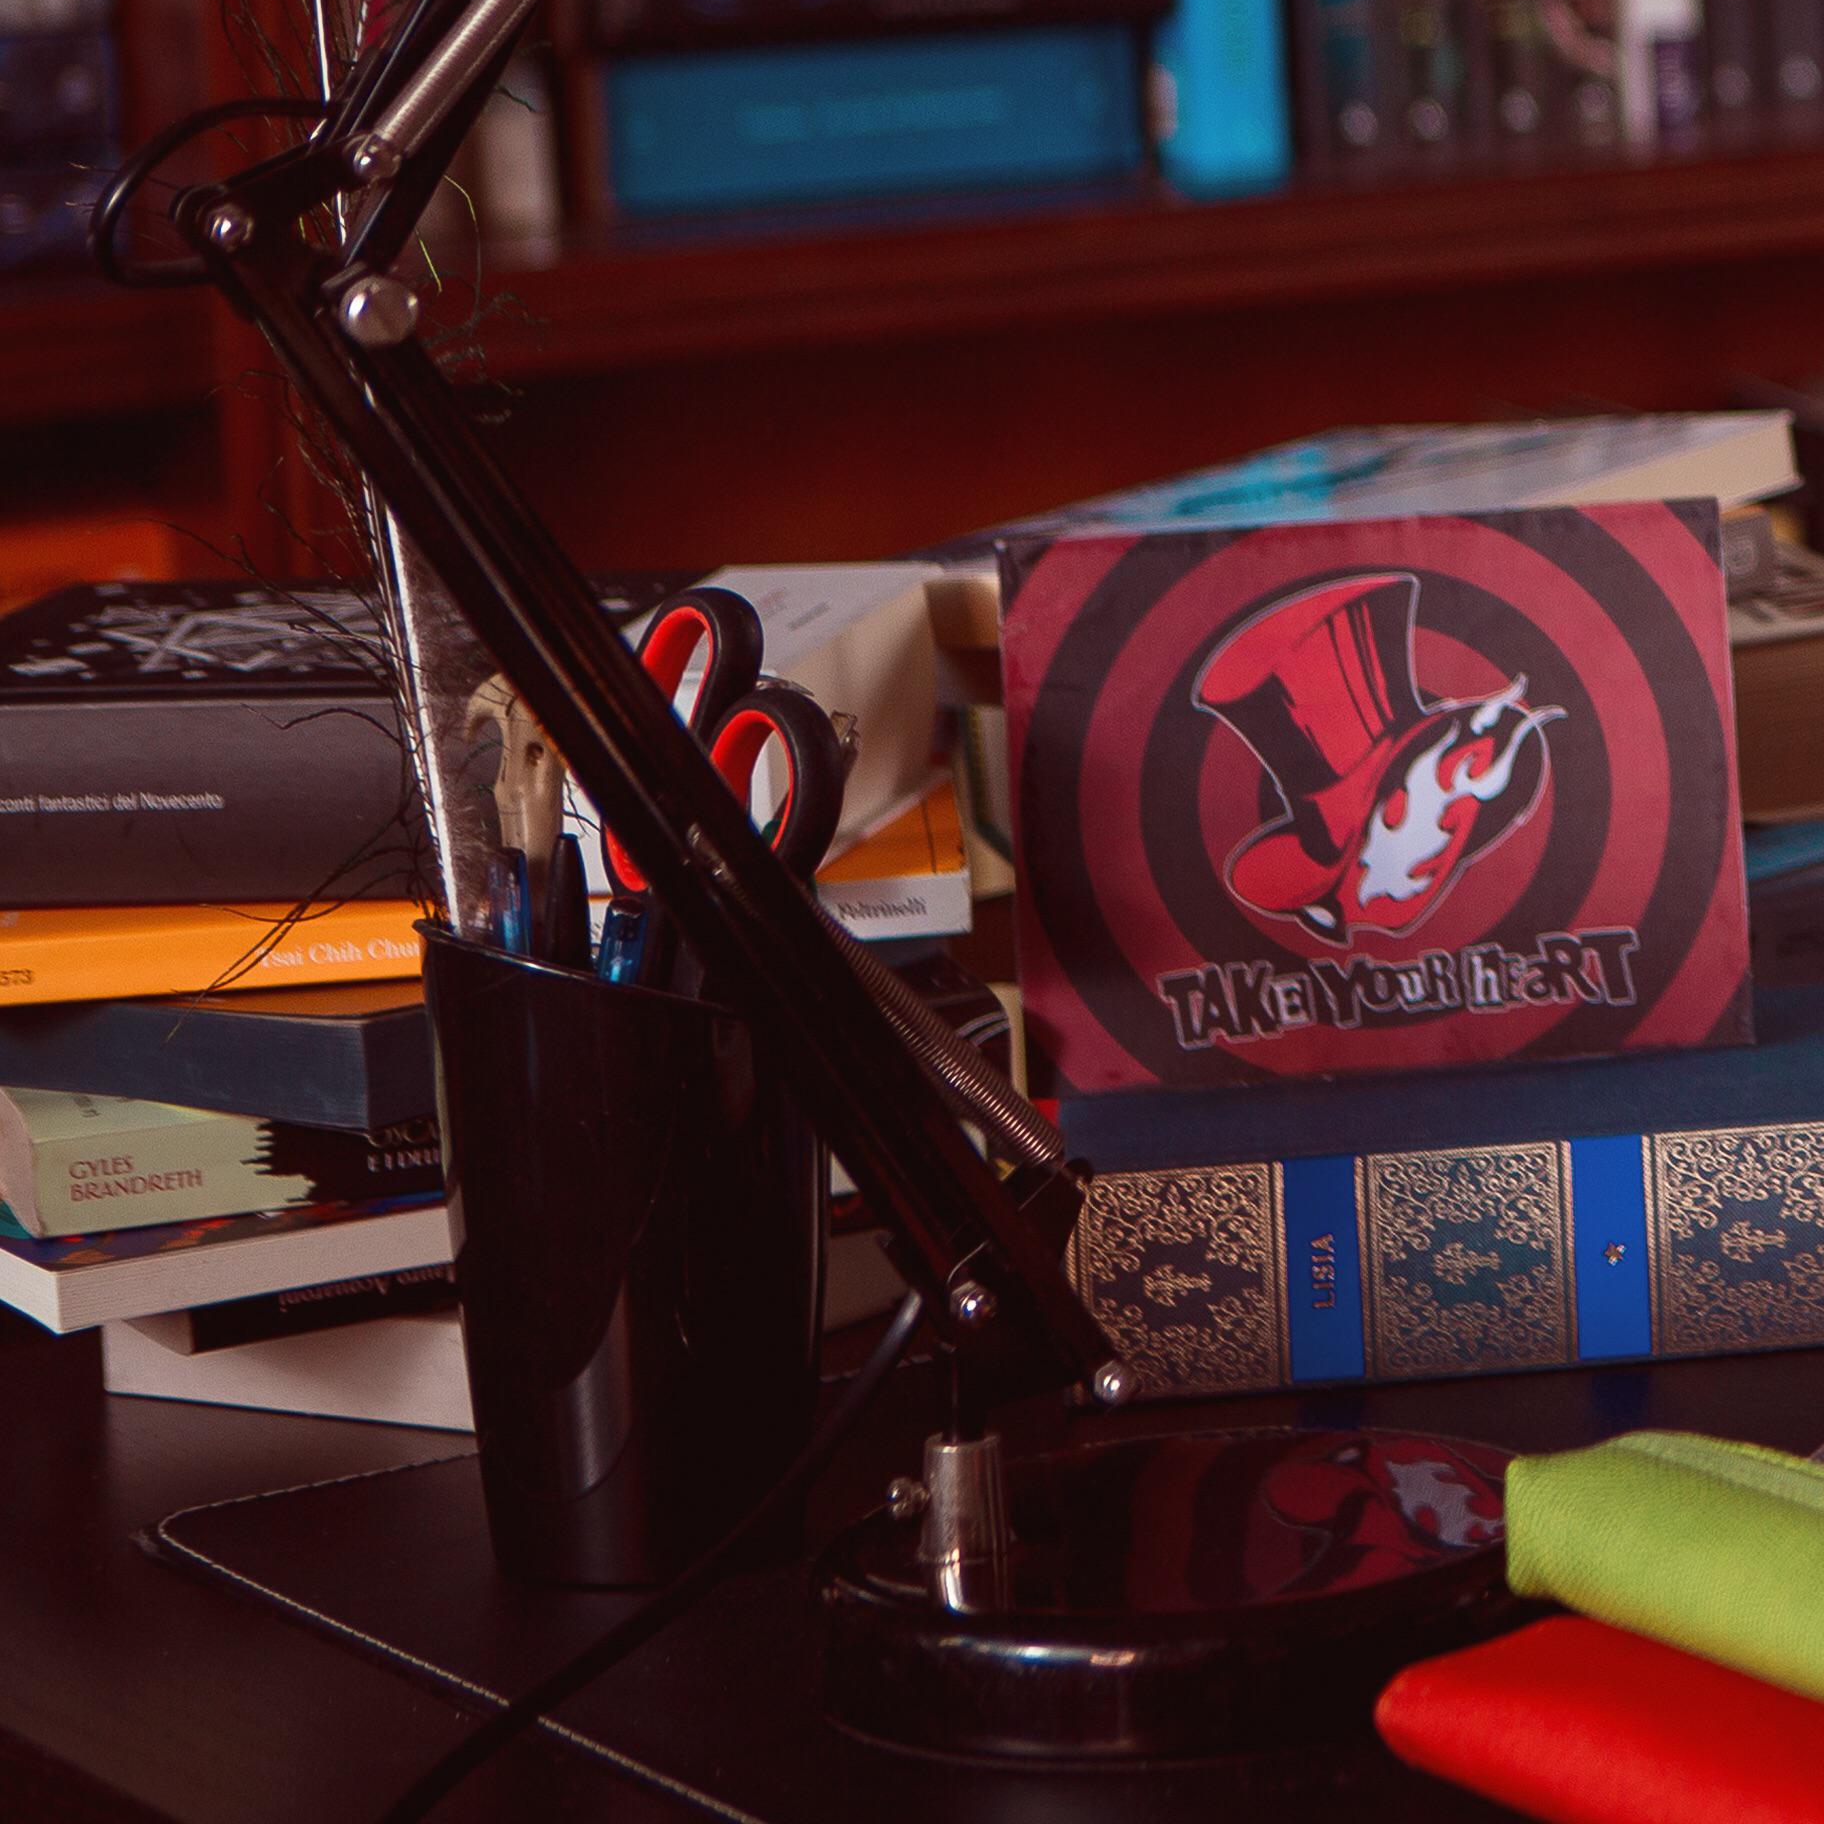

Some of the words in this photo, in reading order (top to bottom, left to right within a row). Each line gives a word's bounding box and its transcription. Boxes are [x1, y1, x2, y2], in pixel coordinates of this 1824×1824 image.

[112, 791, 138, 811] del
[139, 790, 225, 811] Novecento
[69, 1154, 135, 1180] GYLES
[70, 1167, 203, 1202] BRANDRETH
[1310, 1233, 1336, 1309] LISIA
